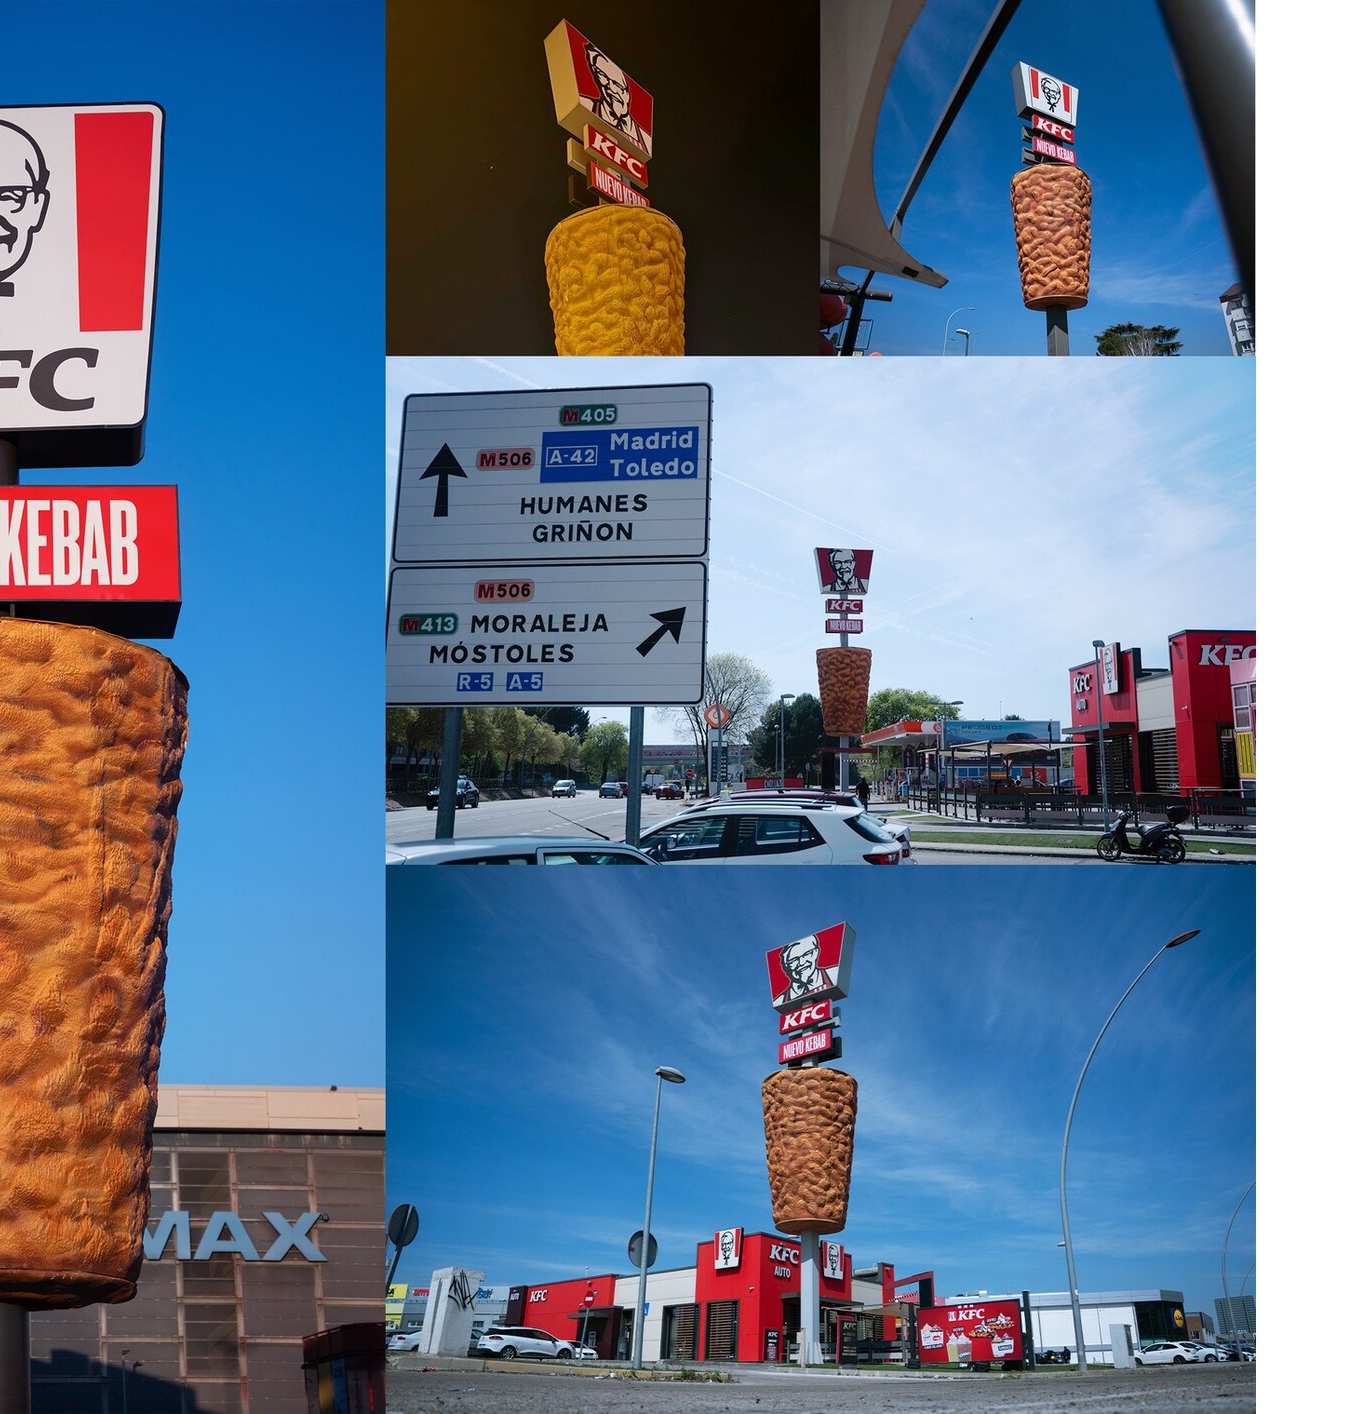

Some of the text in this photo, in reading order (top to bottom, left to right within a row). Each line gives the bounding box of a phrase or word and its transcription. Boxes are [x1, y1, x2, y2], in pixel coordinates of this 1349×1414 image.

[1036, 117, 1072, 141] KFC
[592, 132, 643, 179] KFC
[1036, 139, 1075, 163] NUEVO KEBAB
[594, 167, 623, 202] NUEVO
[479, 430, 693, 468] M506 A-42 Madrid
[609, 457, 695, 477] Toledo
[520, 493, 648, 515] HUMANES
[532, 519, 633, 543] GRIÑON
[477, 582, 531, 599] M506
[830, 600, 860, 611] KFC
[401, 613, 609, 634] M413 MORALEJA
[429, 640, 575, 664] MÓSTOLES
[458, 672, 542, 690] R-5 A-5
[1073, 674, 1091, 694] KFC
[782, 1003, 827, 1030] KFC
[783, 1032, 826, 1060] NUEVO KEBAB
[770, 1244, 799, 1265] KFC
[774, 1266, 791, 1279] AUTO
[530, 1289, 548, 1303] KFC
[957, 1308, 985, 1321] KFC
[843, 1322, 857, 1330] KFC
